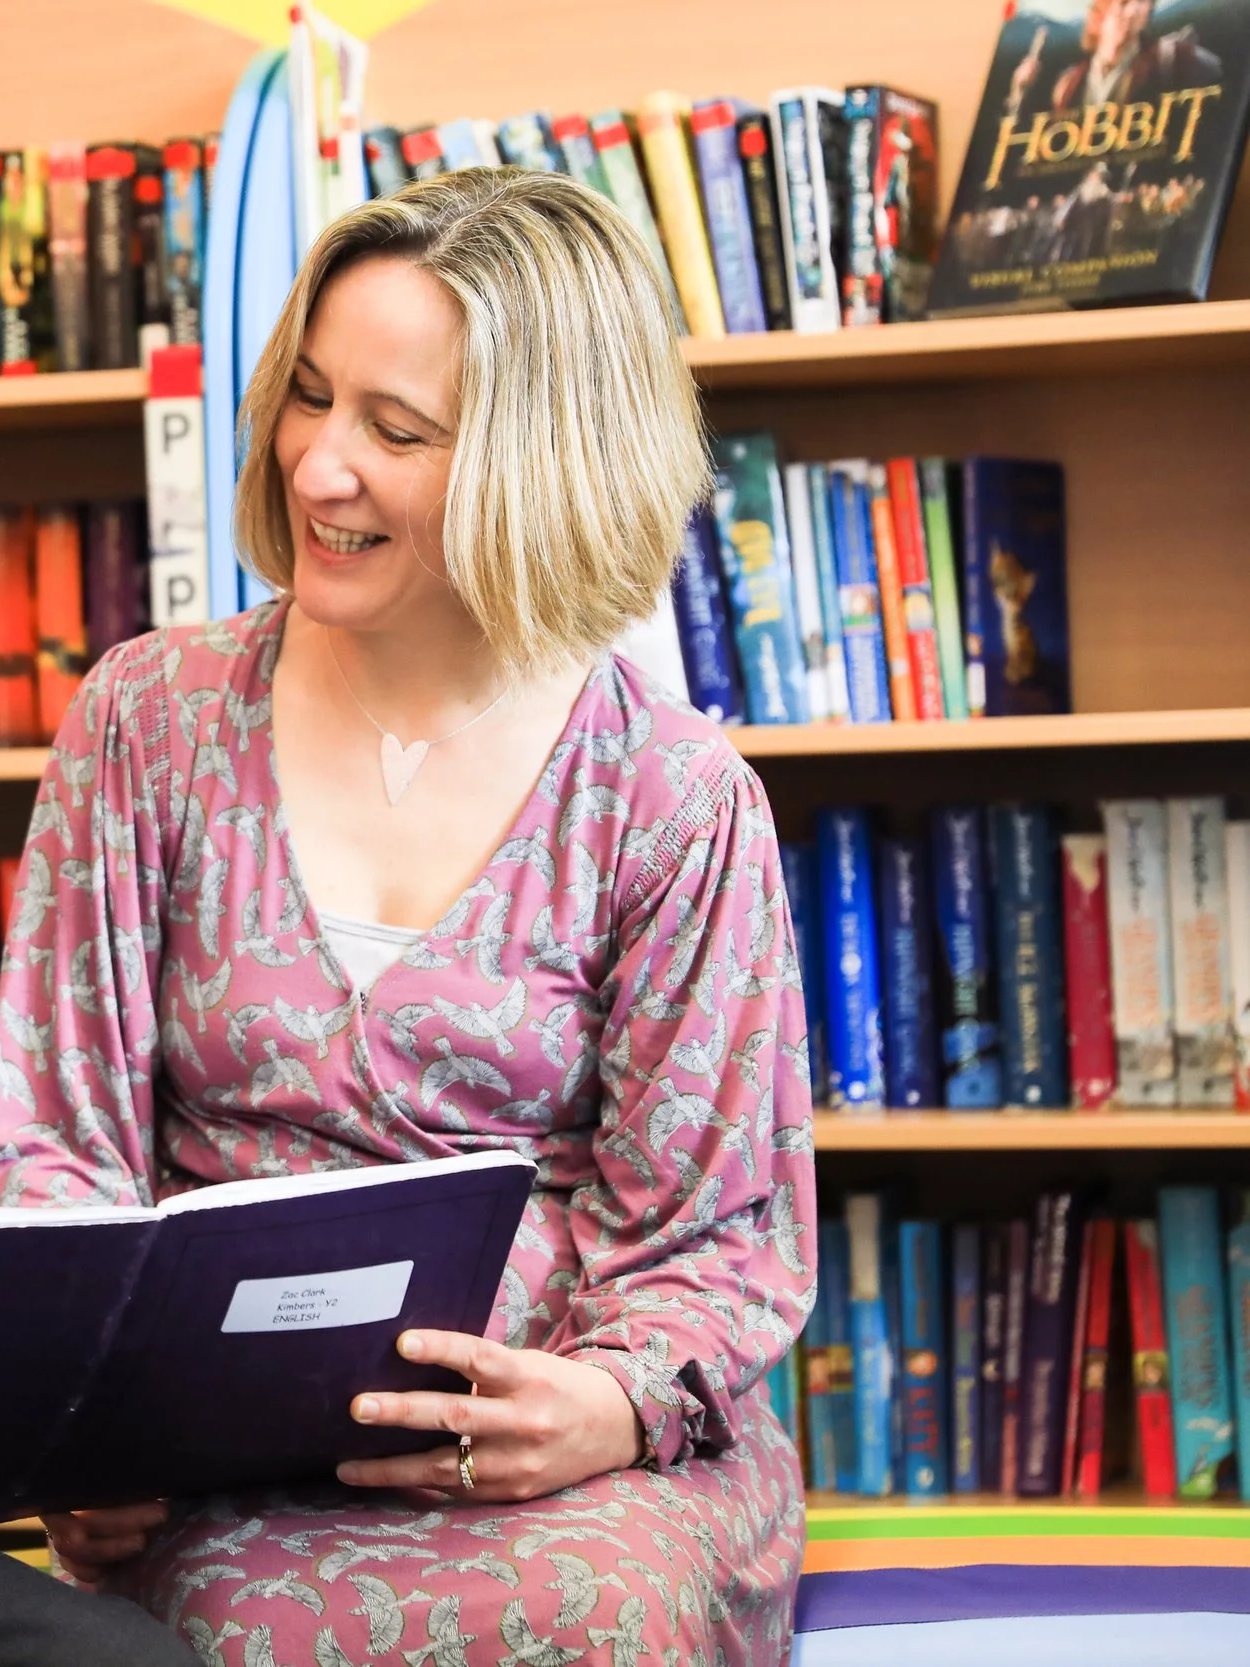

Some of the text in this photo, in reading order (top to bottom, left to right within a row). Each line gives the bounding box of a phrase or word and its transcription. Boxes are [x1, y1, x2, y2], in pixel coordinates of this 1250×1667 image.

[984, 84, 1221, 191] HOBBIT
[162, 411, 190, 454] P
[280, 1288, 326, 1300] Zac Clark
[277, 1302, 316, 1312] Kimbers
[272, 1312, 321, 1324] ENGLISH
